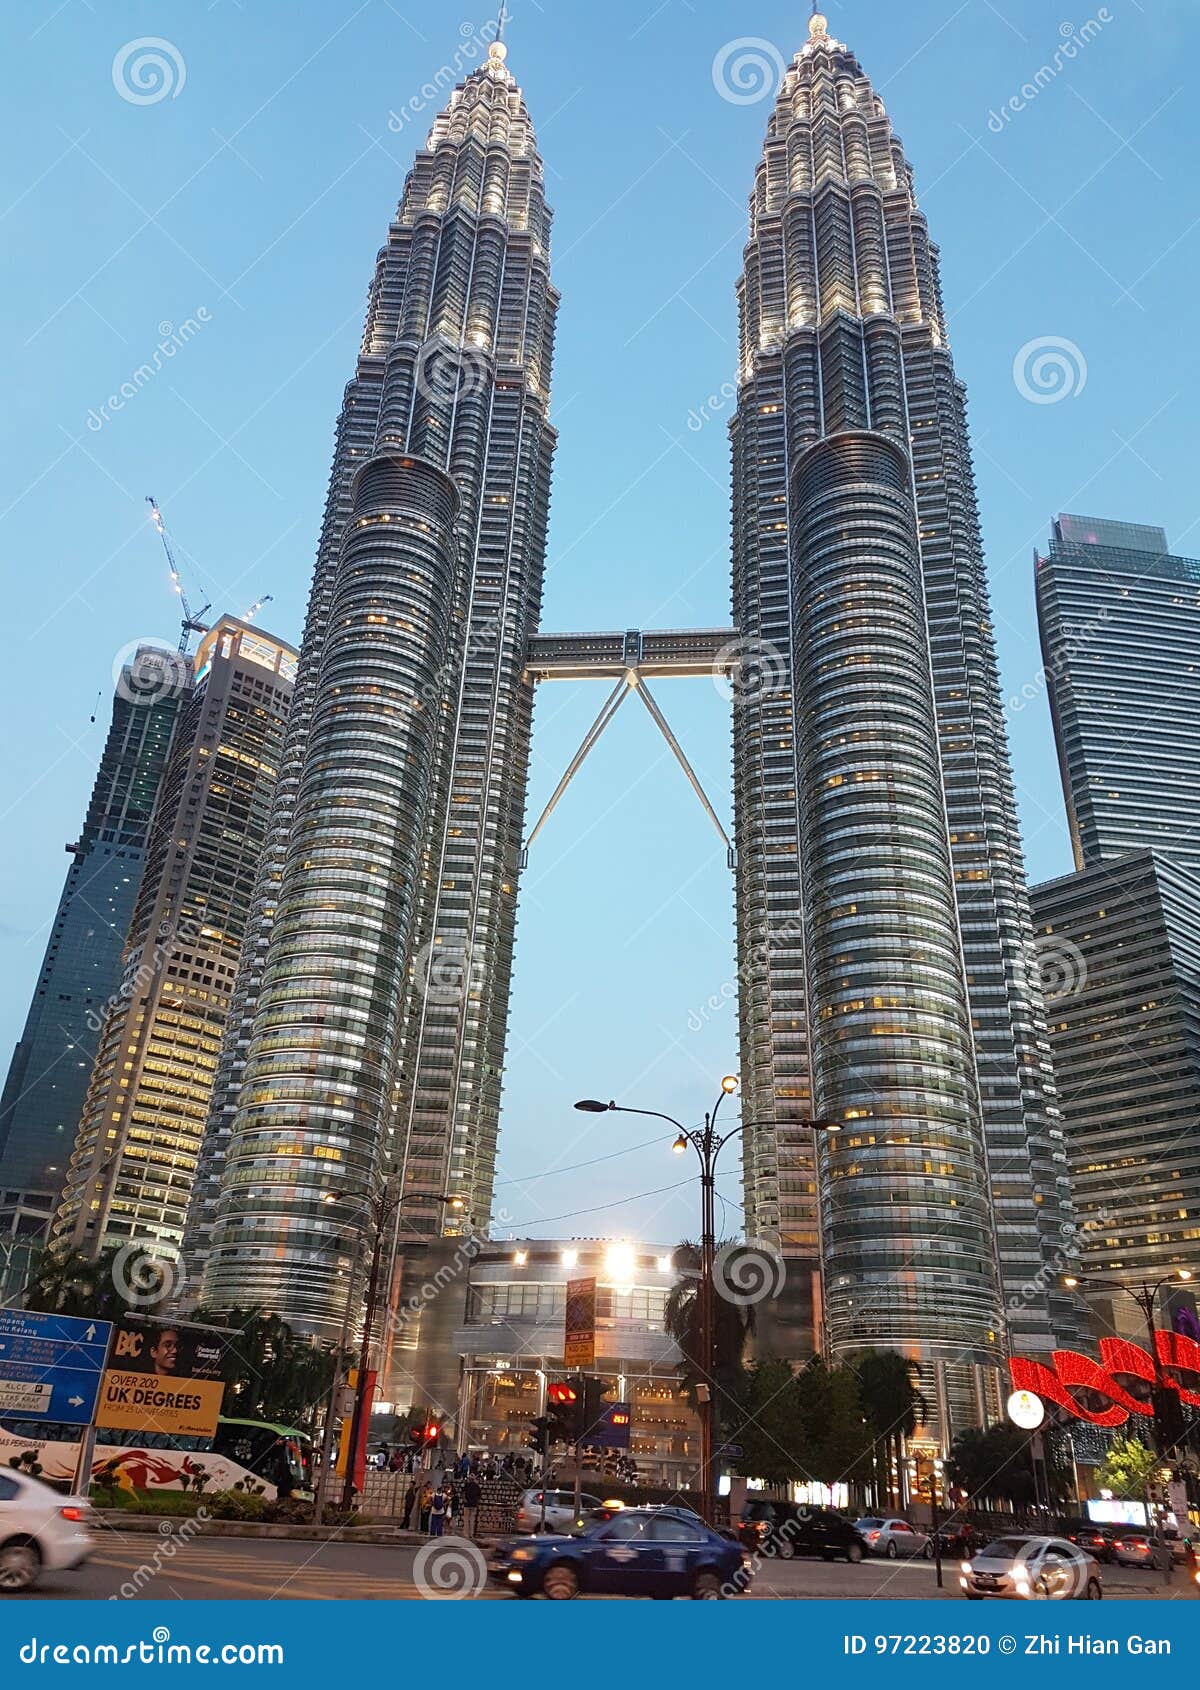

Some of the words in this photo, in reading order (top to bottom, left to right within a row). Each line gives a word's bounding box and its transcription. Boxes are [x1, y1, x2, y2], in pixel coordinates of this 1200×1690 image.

[111, 1374, 139, 1387] OVER
[140, 1377, 160, 1389] 200
[106, 1386, 131, 1404] UK
[133, 1388, 202, 1411] DEGREES
